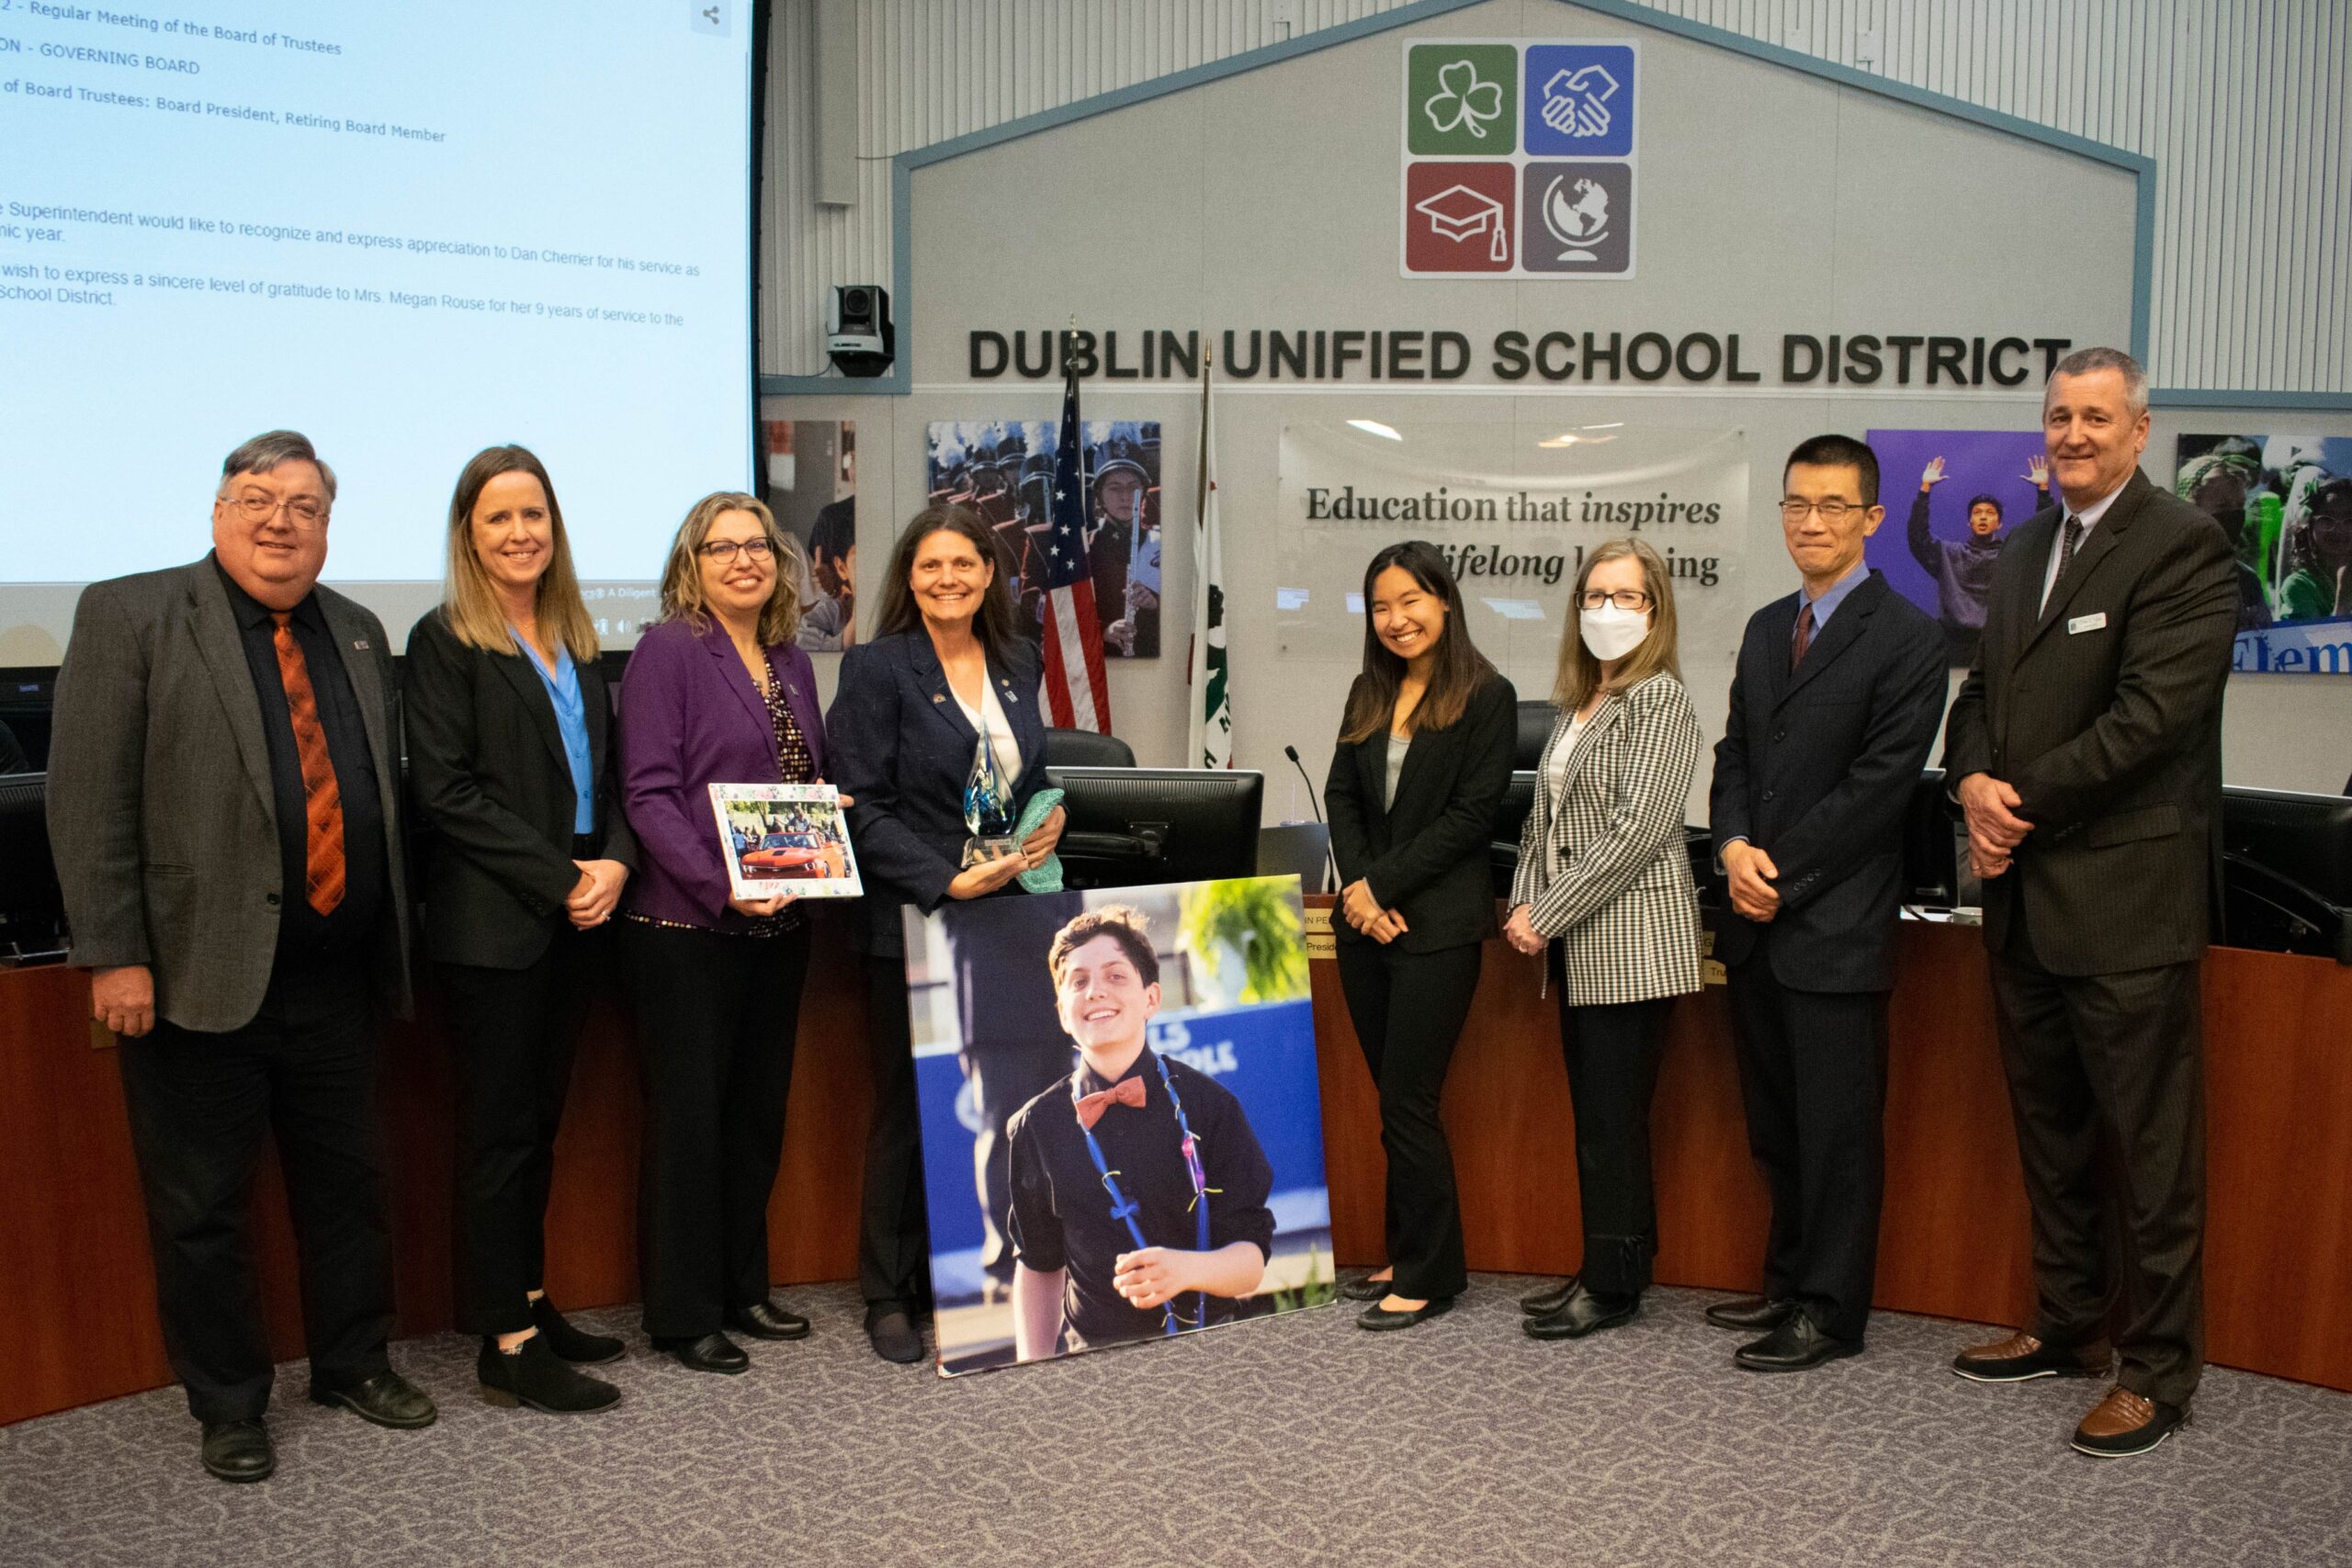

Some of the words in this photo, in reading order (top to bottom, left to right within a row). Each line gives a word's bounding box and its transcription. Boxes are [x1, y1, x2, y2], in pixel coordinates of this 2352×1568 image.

[30, 1, 92, 21] Regular
[97, 10, 159, 32] Meeting
[164, 20, 181, 33] of
[184, 22, 209, 38] the
[214, 26, 258, 45] Board
[263, 33, 278, 46] of
[282, 36, 343, 55] Trustees
[40, 43, 141, 67] GOVERNING
[145, 56, 200, 75] BOARD
[4, 79, 20, 94] of
[26, 82, 73, 100] Board
[78, 88, 150, 108] Trustees:
[156, 96, 201, 115] Board
[207, 103, 280, 125] President,
[286, 113, 341, 133] Retiring
[345, 119, 387, 137] Board
[390, 124, 447, 143] Member
[9, 201, 134, 227] Superintendent
[139, 213, 185, 231] would
[189, 218, 216, 232] like
[220, 220, 235, 234] to
[239, 221, 311, 242] recognize
[315, 229, 344, 244] and
[347, 231, 403, 251] express
[407, 236, 491, 257] appreciation
[494, 245, 508, 259] to
[511, 246, 538, 262] Dan
[597, 254, 615, 268] for
[617, 257, 636, 271] his
[639, 260, 683, 276] service
[685, 264, 701, 276] as
[26, 226, 66, 243] year.
[0, 285, 52, 302] School
[57, 288, 118, 307] District.
[2, 264, 40, 279] wish
[44, 265, 61, 280] to
[64, 268, 130, 287] express
[133, 274, 144, 287] a
[148, 274, 205, 291] sincere
[209, 277, 246, 293] level
[249, 281, 265, 295] of
[267, 283, 334, 302] gratitude
[336, 287, 351, 300] to
[355, 288, 385, 304] Mrs.
[390, 291, 437, 310] Megan
[442, 295, 486, 311] Rouse
[489, 299, 507, 312] for
[510, 300, 532, 315] her
[536, 303, 545, 315] 9
[548, 306, 583, 321] years
[586, 307, 599, 320] of
[602, 310, 647, 324] service
[650, 312, 662, 325] to
[664, 313, 684, 327] the
[970, 331, 1199, 378] DUBLIN
[1224, 331, 1471, 379] UNIFIED
[1491, 331, 1761, 382] SCHOOL
[1781, 334, 2072, 386] DISTRICT
[1306, 486, 1498, 524] Education
[1506, 491, 1572, 524] that
[1581, 491, 1721, 531] inspires
[1574, 546, 1720, 586] ling
